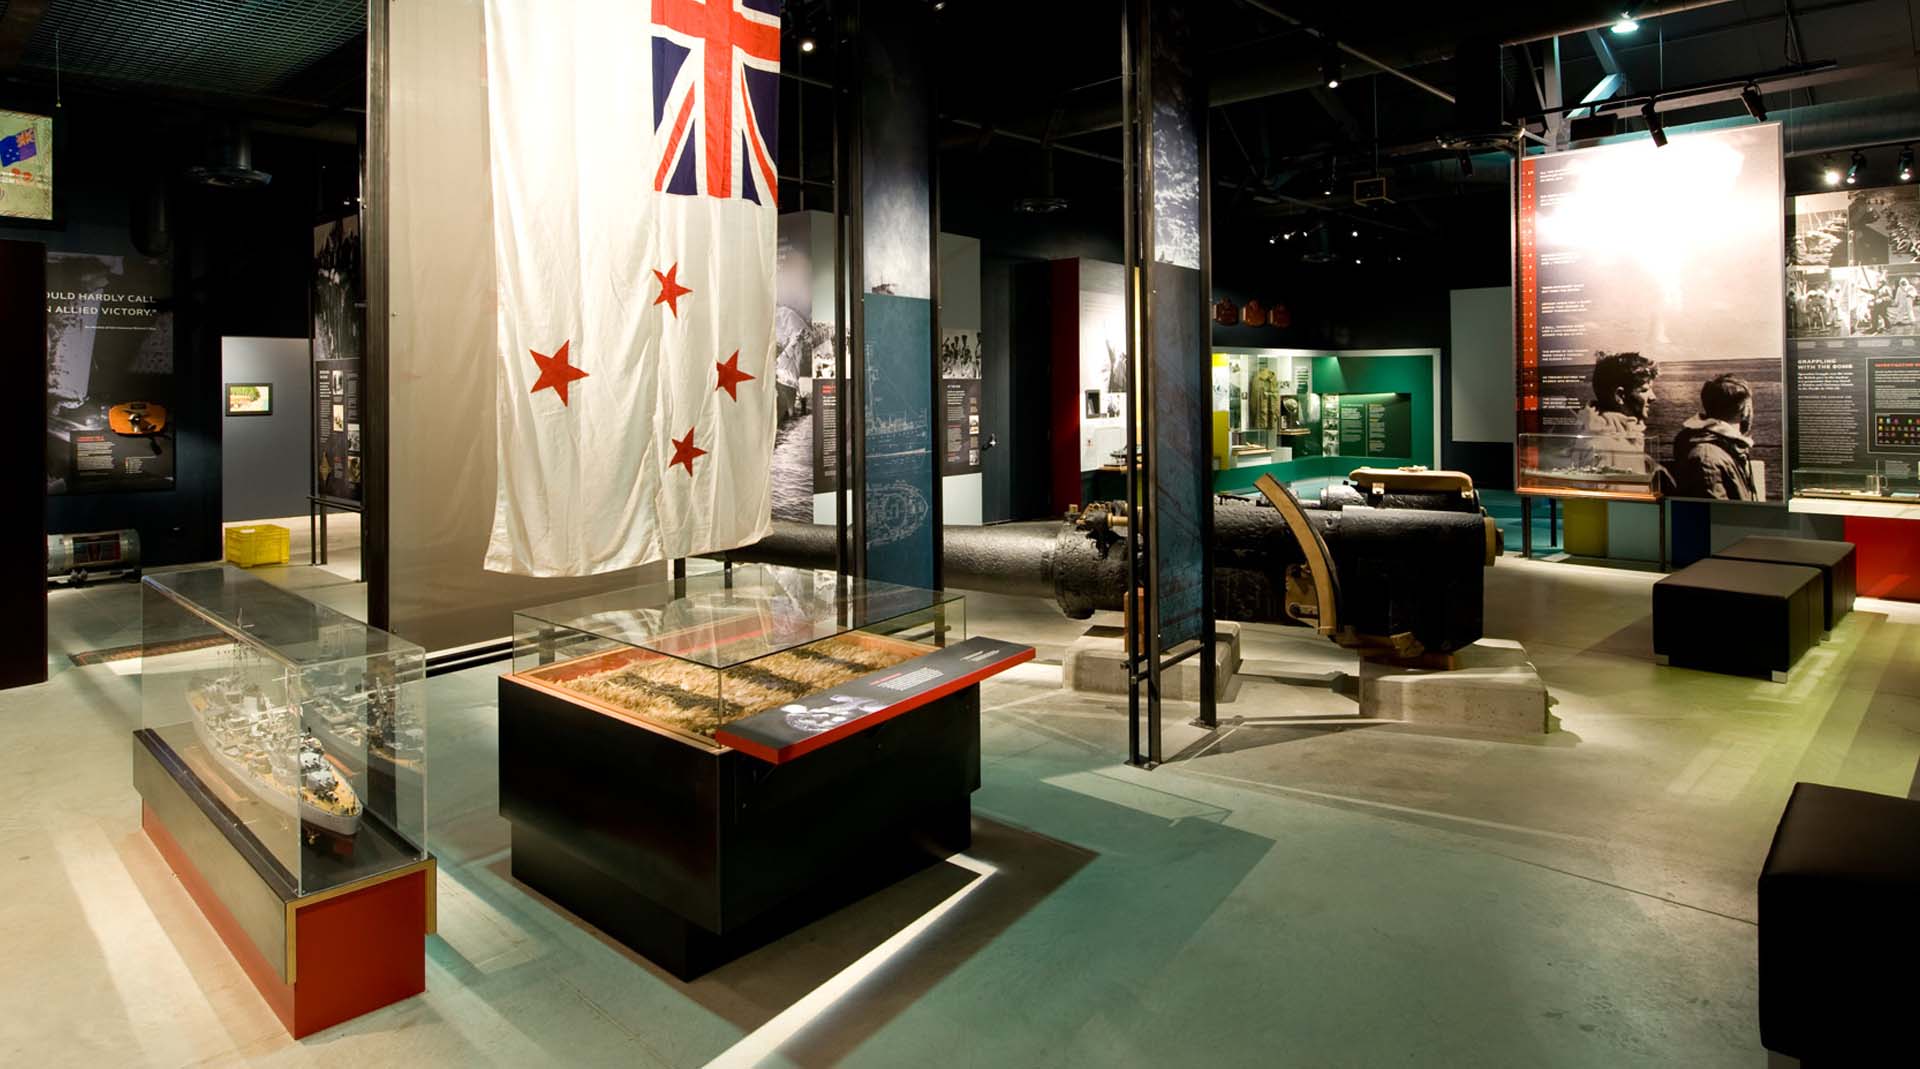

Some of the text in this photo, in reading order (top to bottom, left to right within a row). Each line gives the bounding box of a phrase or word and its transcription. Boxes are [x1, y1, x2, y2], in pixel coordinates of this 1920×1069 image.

[78, 293, 125, 302] HARDLY
[128, 295, 156, 303] CALL
[55, 306, 98, 314] ALLIED
